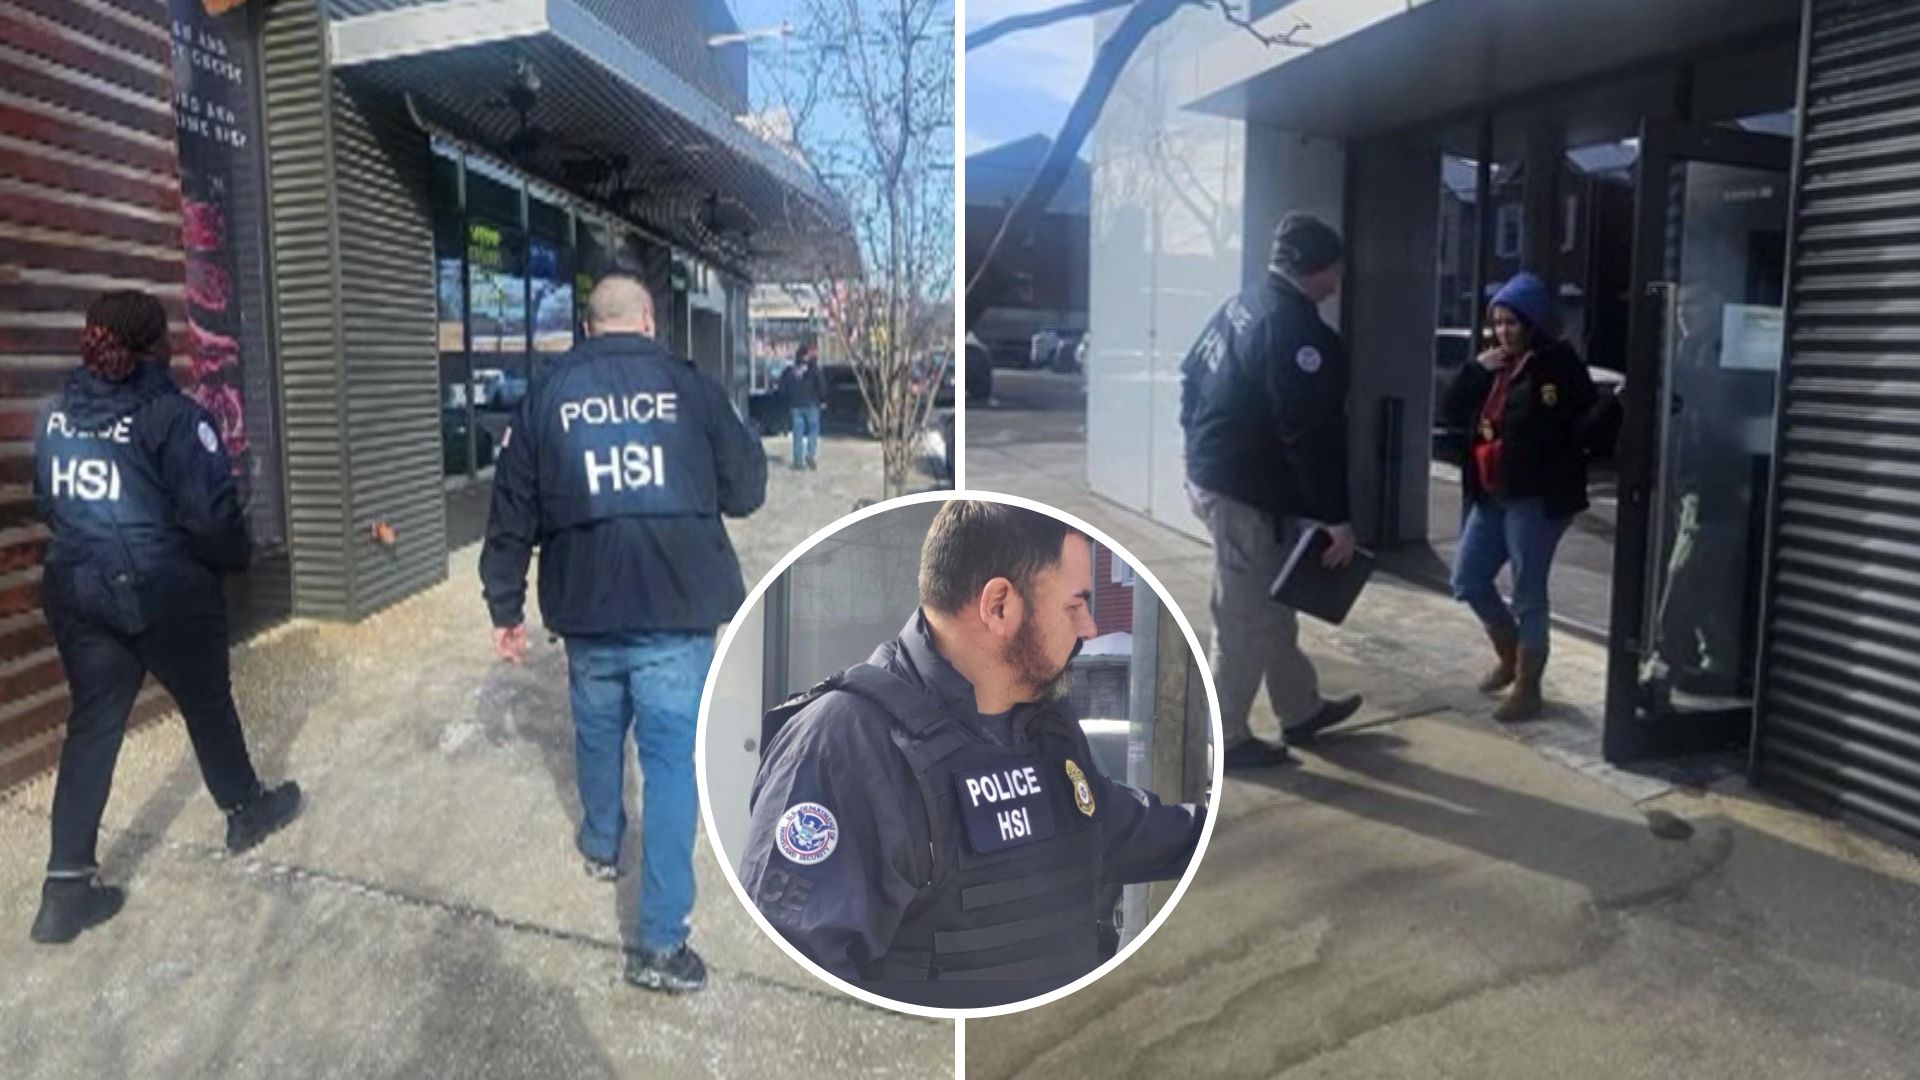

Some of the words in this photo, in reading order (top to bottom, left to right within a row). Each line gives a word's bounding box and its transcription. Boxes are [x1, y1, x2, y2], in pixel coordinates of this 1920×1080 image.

[46, 411, 134, 443] POE
[560, 391, 679, 433] POLICE
[51, 456, 121, 502] HSI
[584, 442, 665, 496] HSI
[965, 766, 1042, 808] POLICE
[996, 806, 1032, 841] HSI
